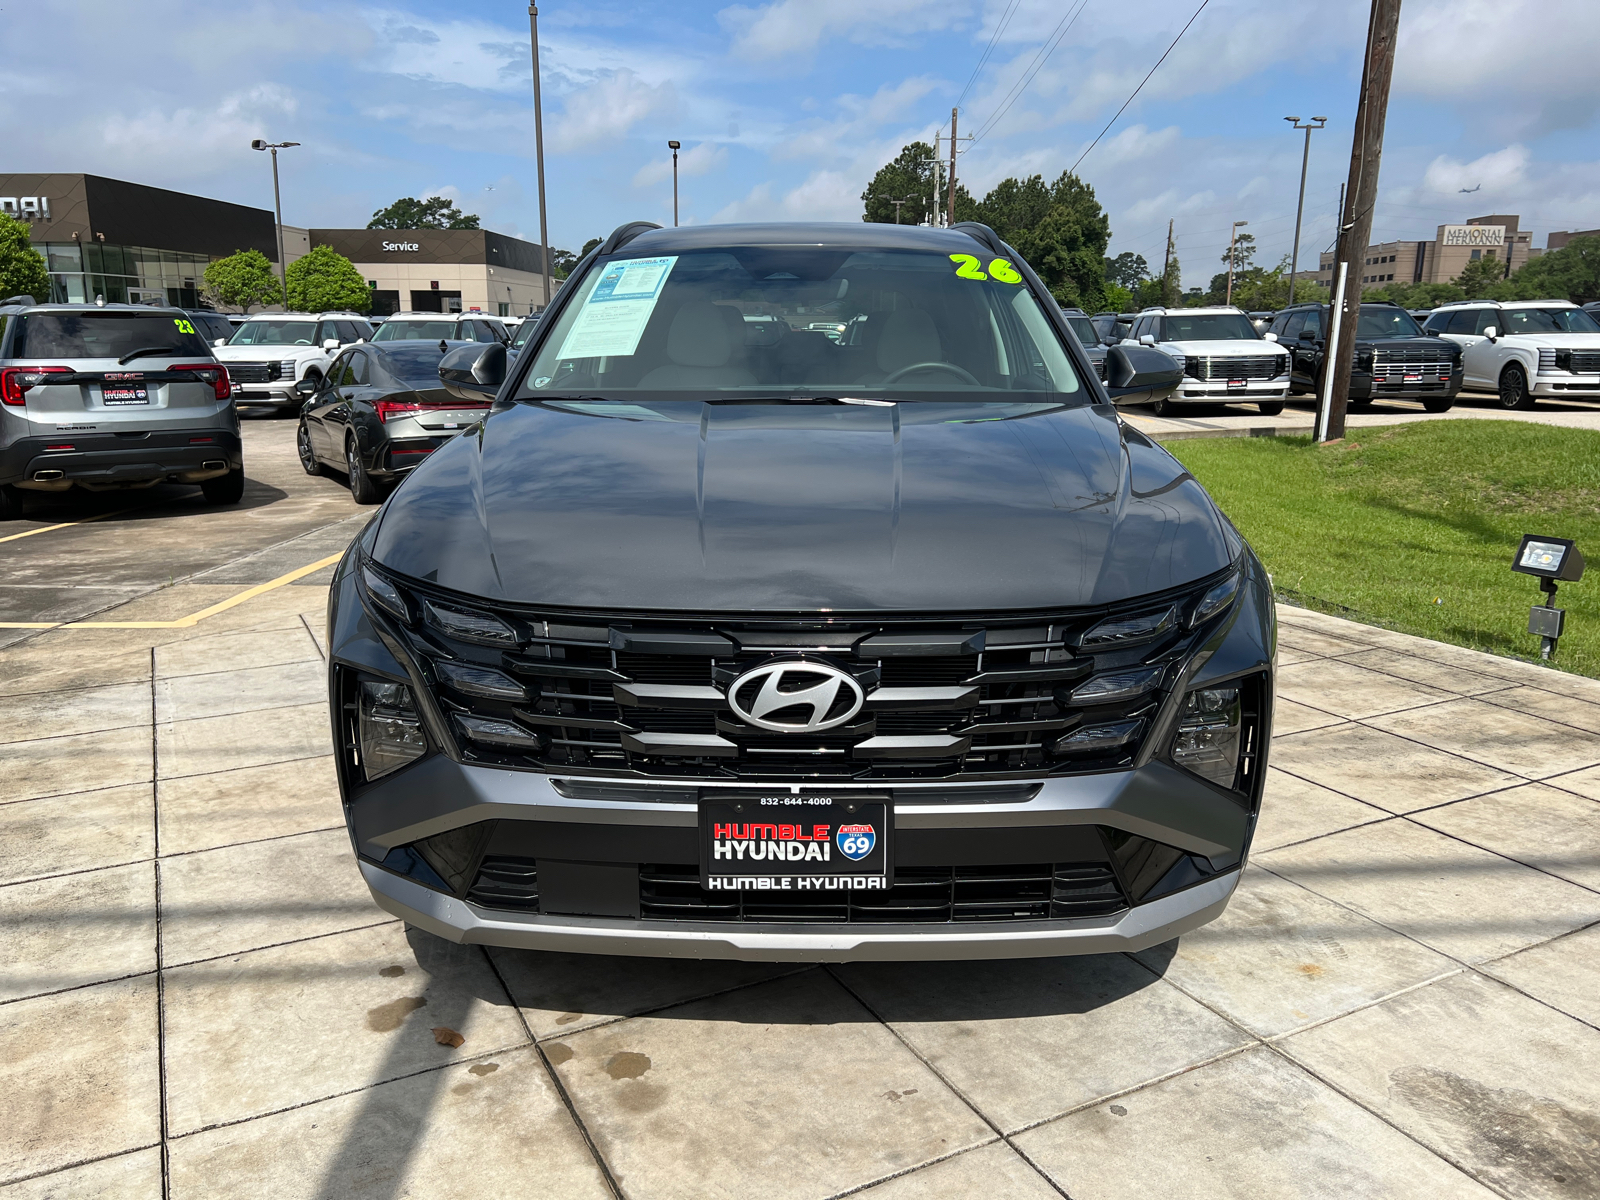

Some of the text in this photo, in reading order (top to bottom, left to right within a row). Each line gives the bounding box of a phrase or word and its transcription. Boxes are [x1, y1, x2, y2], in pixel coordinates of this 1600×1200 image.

[1447, 229, 1501, 237] MEMORIAL
[382, 241, 419, 251] Service
[1446, 236, 1502, 244] HERMANN
[949, 253, 1022, 284] 26
[174, 319, 195, 334] 23
[104, 372, 144, 380] GMC
[760, 798, 832, 806] 832-644-4000
[714, 823, 830, 841] HUMBLE
[714, 841, 830, 861] HYUNDAI
[843, 837, 870, 854] 69
[708, 877, 887, 890] HUMBLE HYUNDAI
